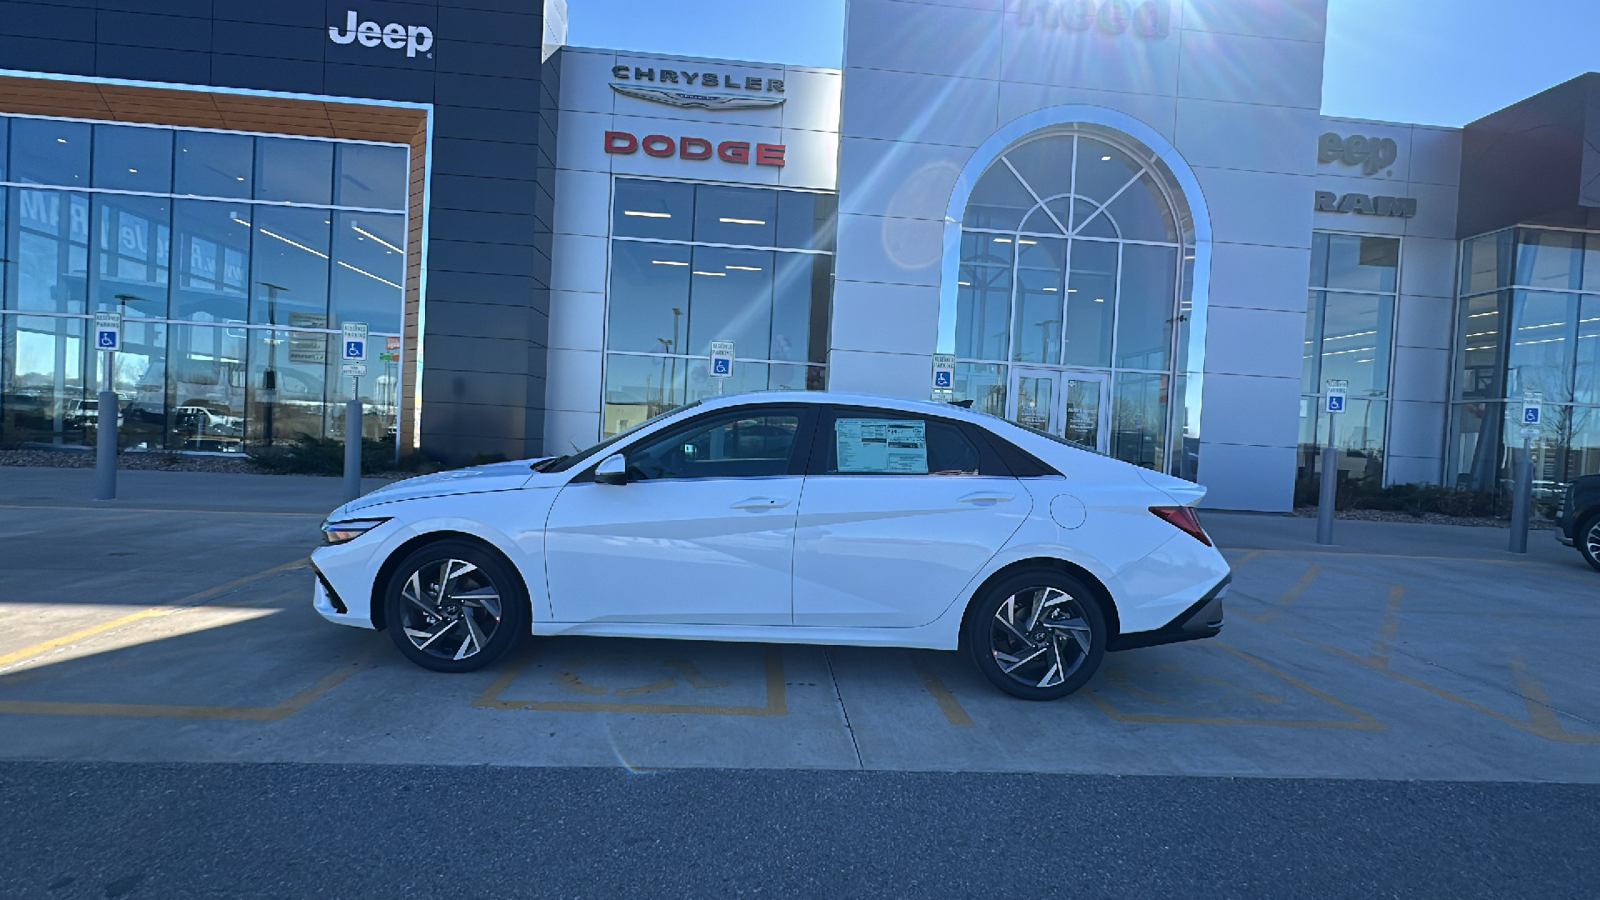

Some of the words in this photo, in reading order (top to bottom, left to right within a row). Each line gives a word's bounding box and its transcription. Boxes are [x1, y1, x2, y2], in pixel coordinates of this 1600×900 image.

[328, 10, 434, 58] Jeep
[611, 65, 786, 93] CHRYSLER
[604, 130, 786, 168] DODGE
[1314, 190, 1417, 218] RAM
